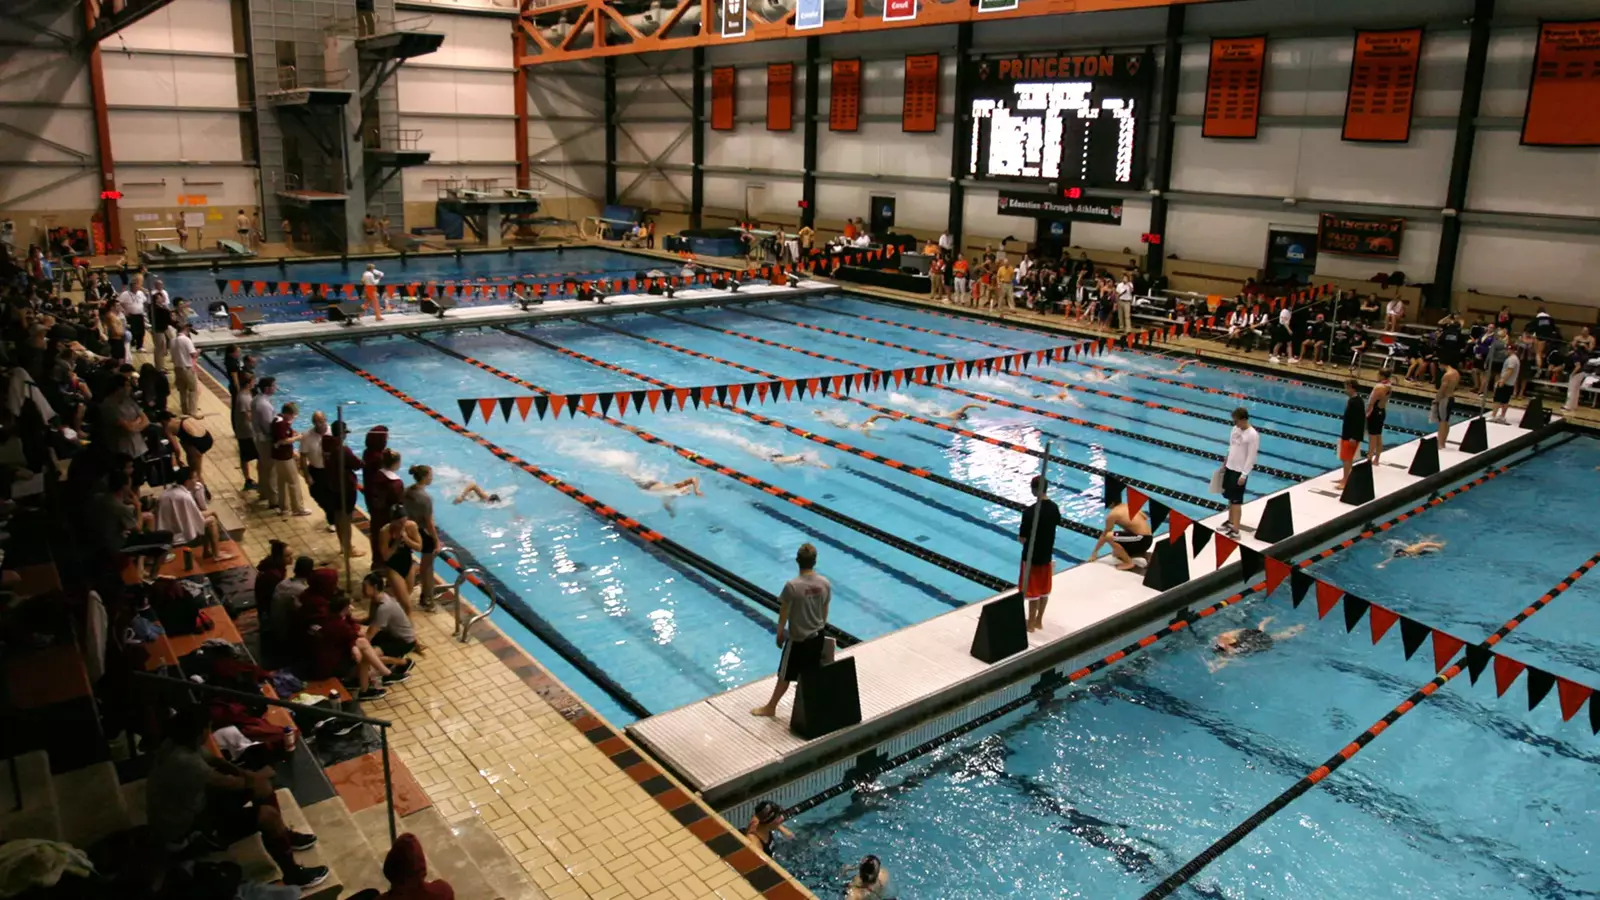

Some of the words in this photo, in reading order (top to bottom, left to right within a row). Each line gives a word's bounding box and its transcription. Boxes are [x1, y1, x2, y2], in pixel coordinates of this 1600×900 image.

[999, 55, 1114, 79] PRINCETON
[1009, 199, 1041, 209] Education
[1044, 202, 1073, 213] Through
[1076, 204, 1109, 215] Athletics
[1325, 219, 1399, 231] PRINCETON
